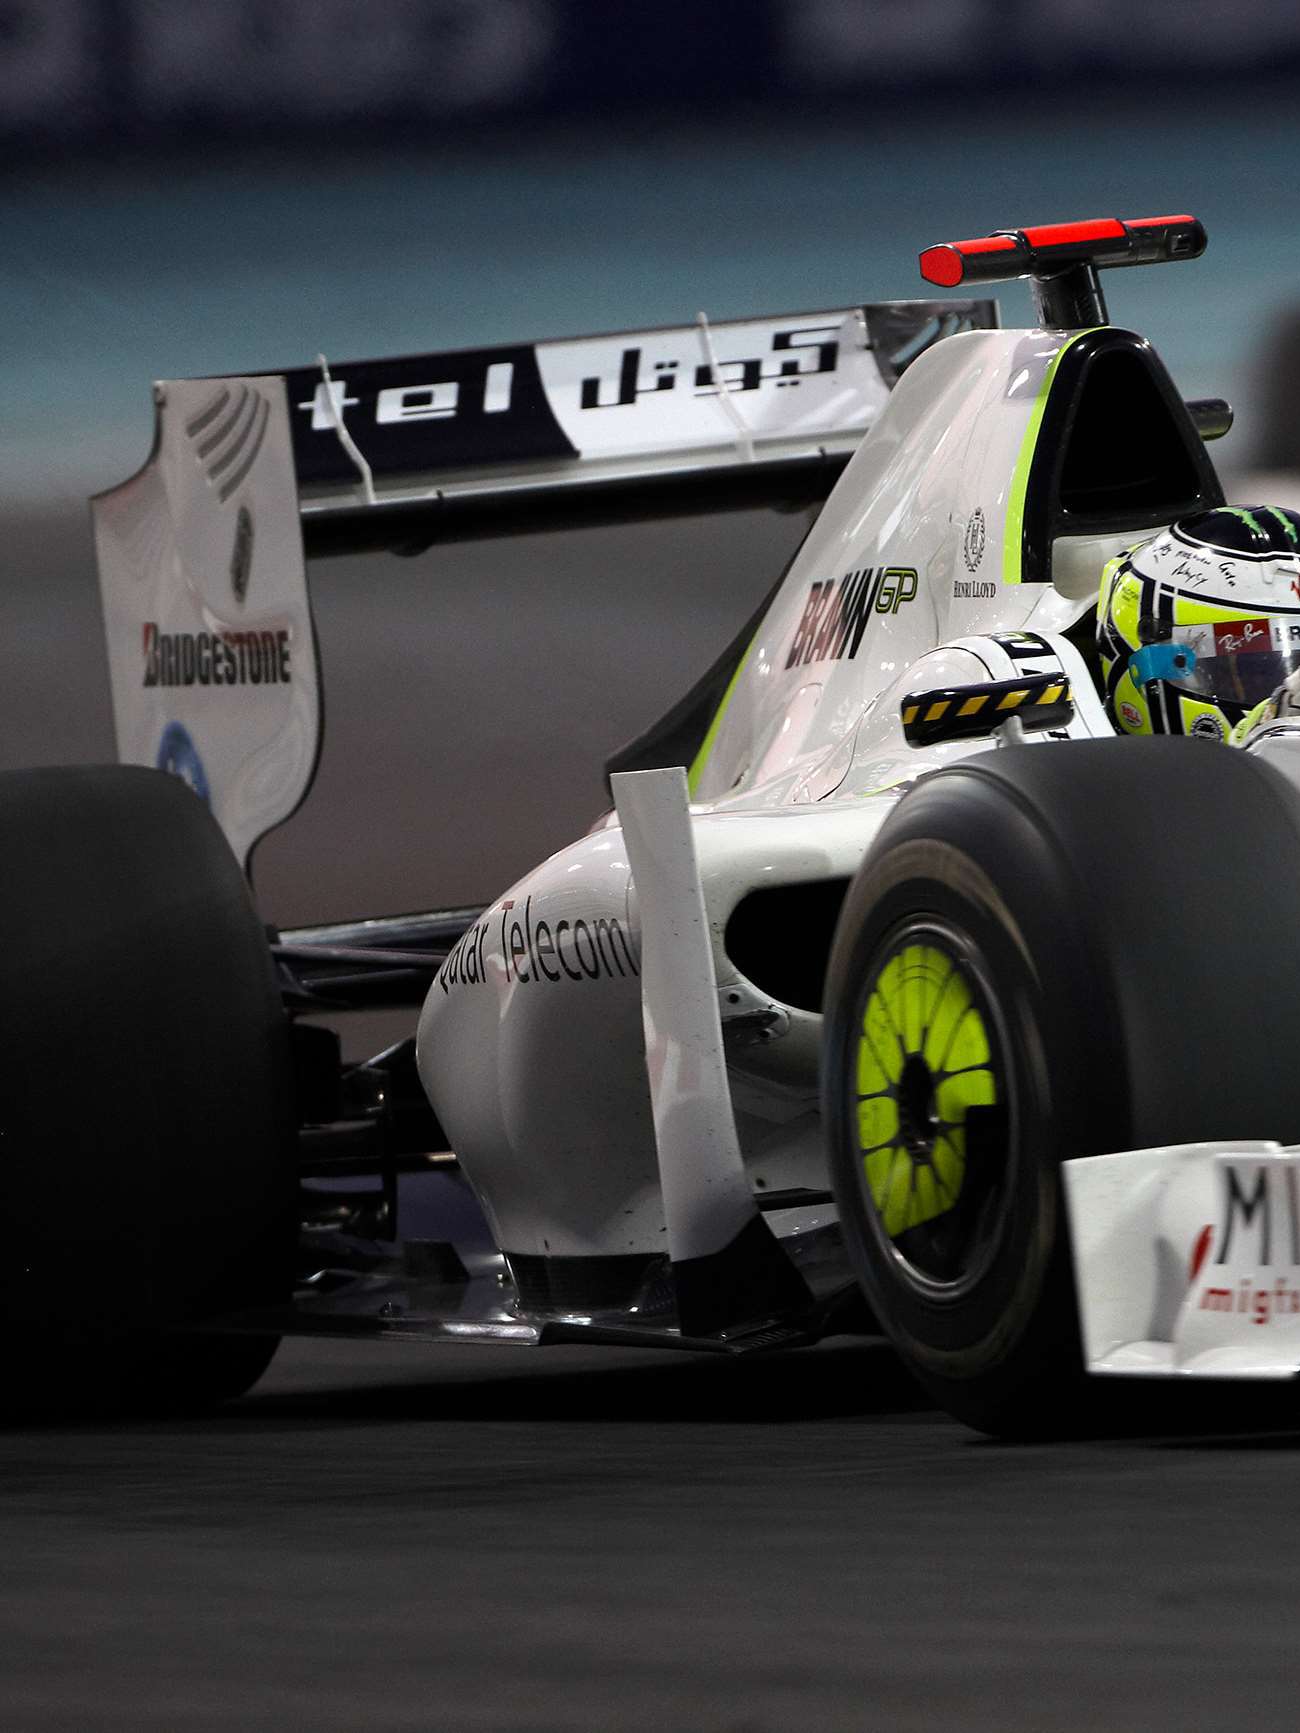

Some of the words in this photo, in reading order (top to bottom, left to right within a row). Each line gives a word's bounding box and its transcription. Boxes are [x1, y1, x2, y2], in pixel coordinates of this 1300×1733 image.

[972, 580, 997, 598] LLOYD
[143, 622, 292, 688] BRIDGESTONE
[501, 895, 639, 983] Telecom
